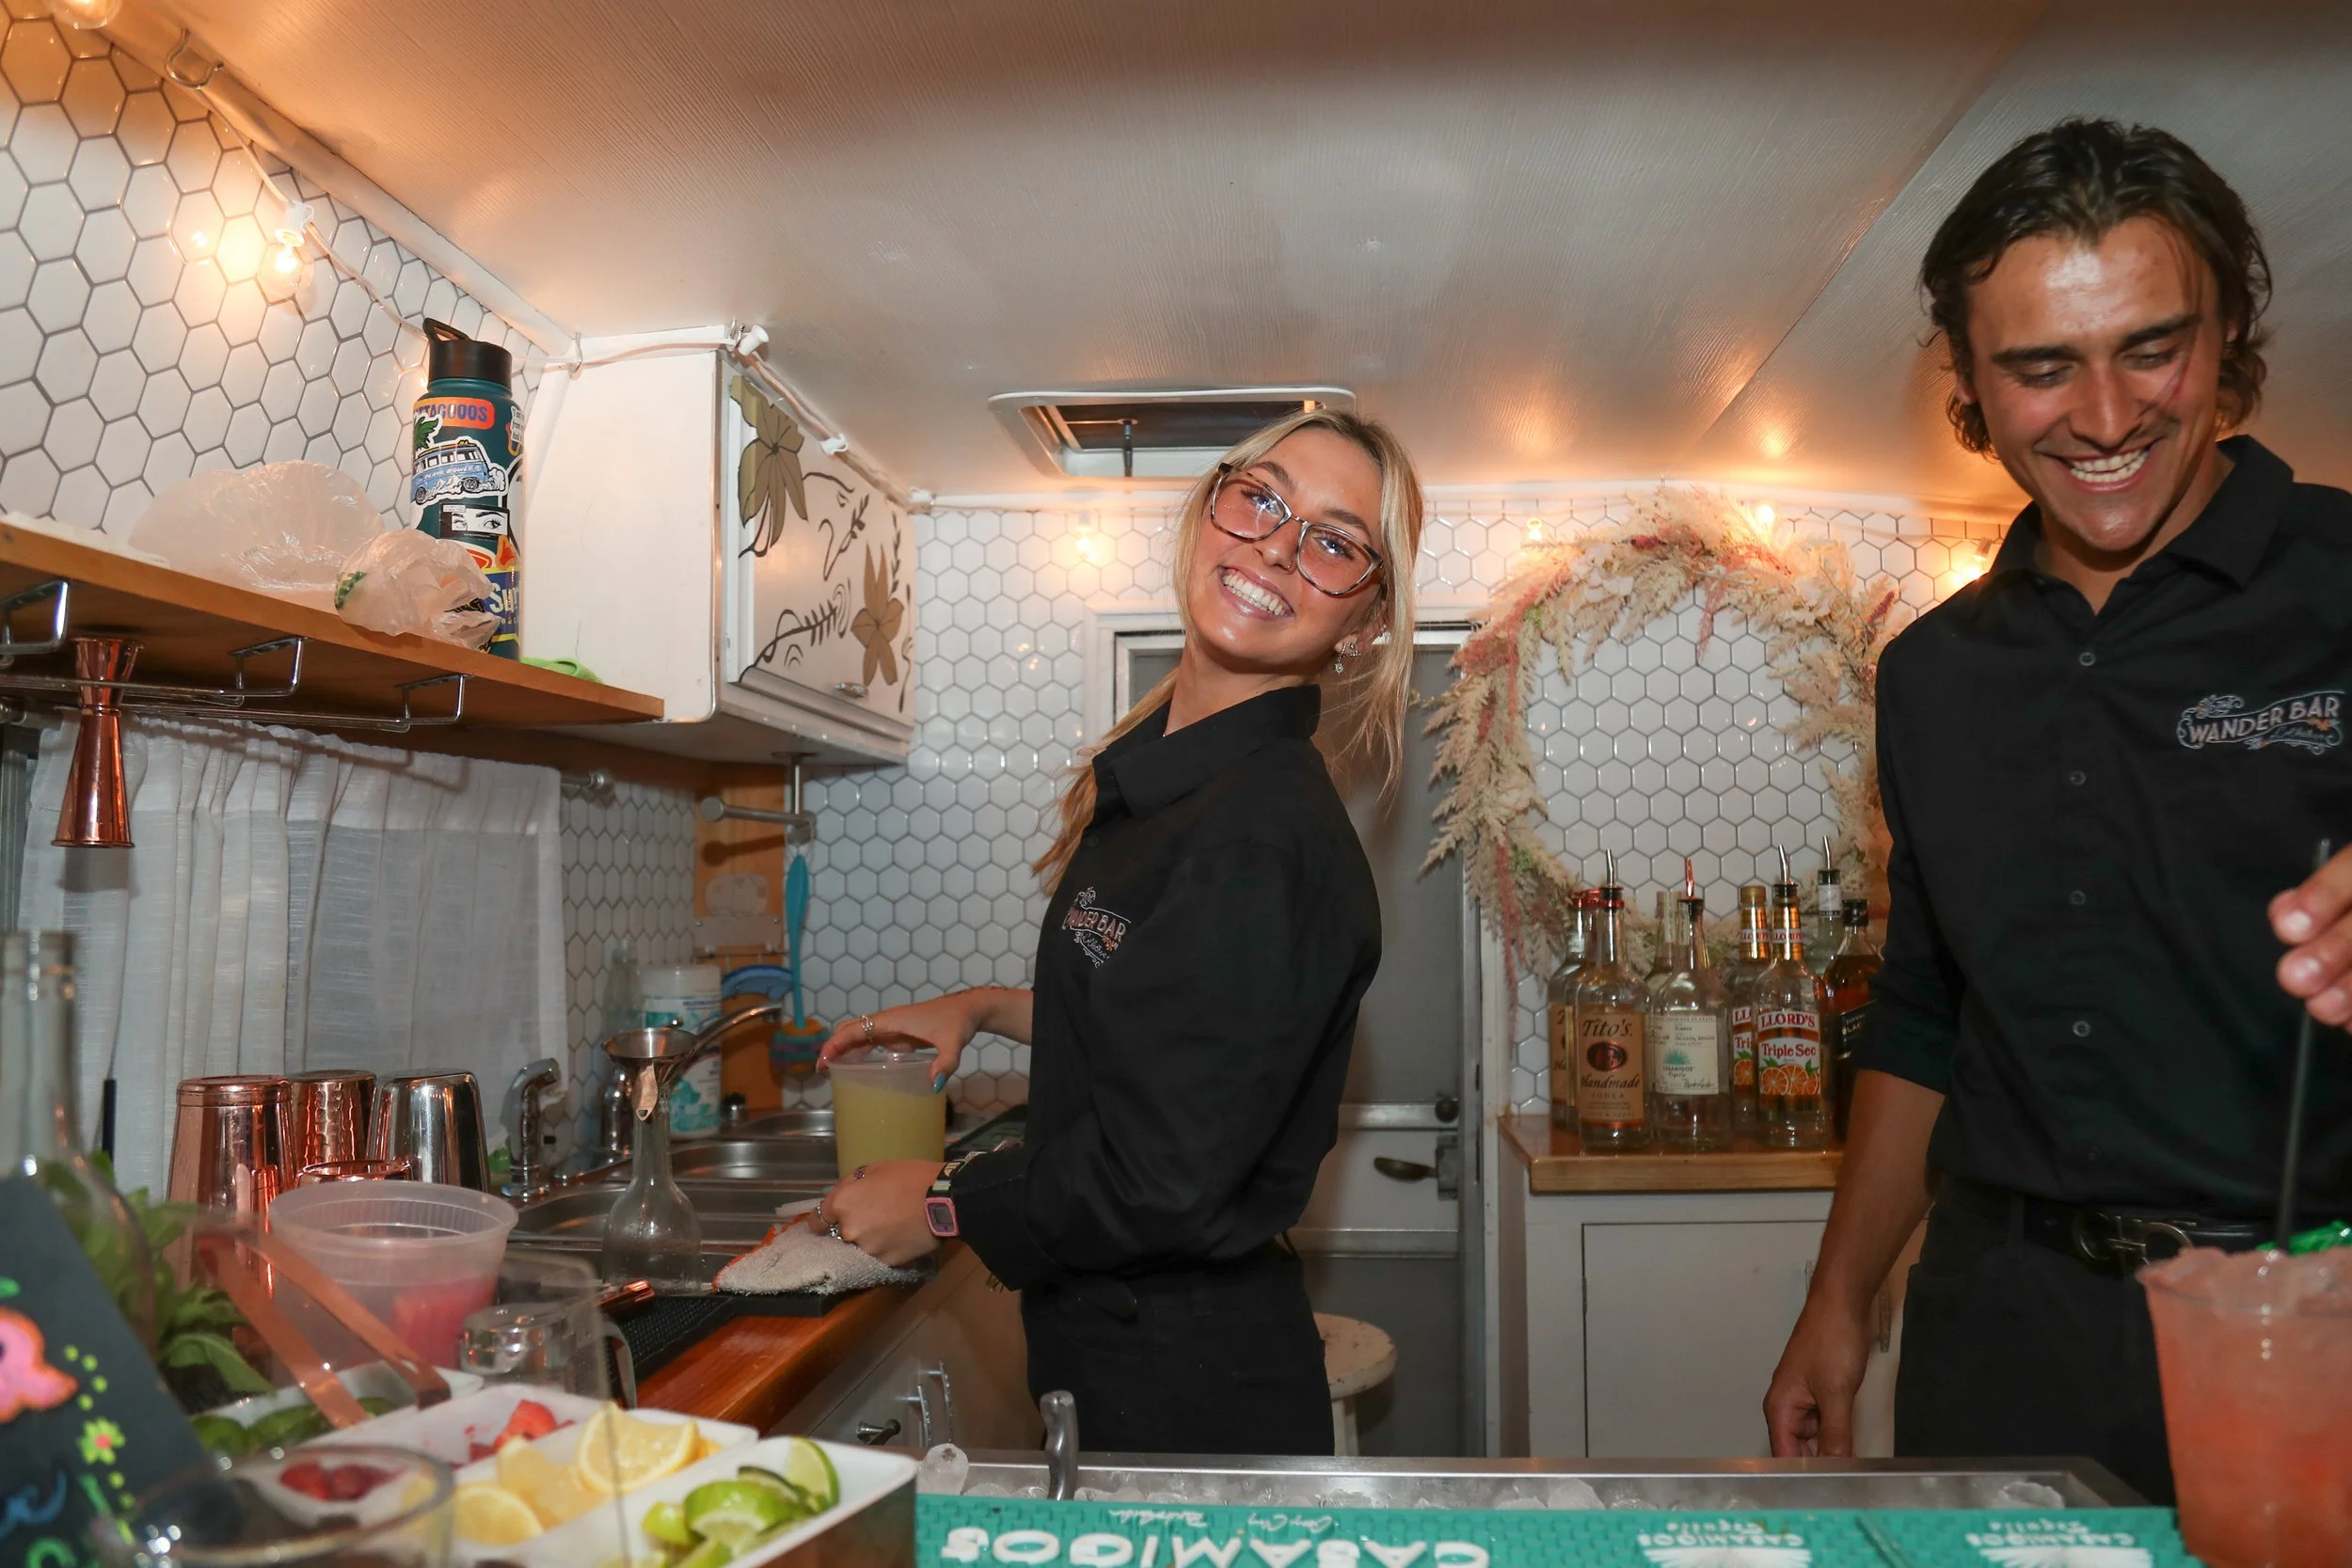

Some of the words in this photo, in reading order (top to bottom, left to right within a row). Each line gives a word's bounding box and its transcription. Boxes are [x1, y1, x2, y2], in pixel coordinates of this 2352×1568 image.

[2189, 707, 2284, 743] WANDER
[2288, 695, 2340, 721] BAR
[1097, 914, 1126, 942] BAR
[1761, 1013, 1816, 1028] LLORD'S
[1735, 1037, 1751, 1049] Tri
[1762, 1042, 1794, 1059] Triple
[1795, 1043, 1817, 1057] Sec
[1581, 1074, 1640, 1088] Handmade
[942, 1527, 1489, 1568] CASAMIGOS
